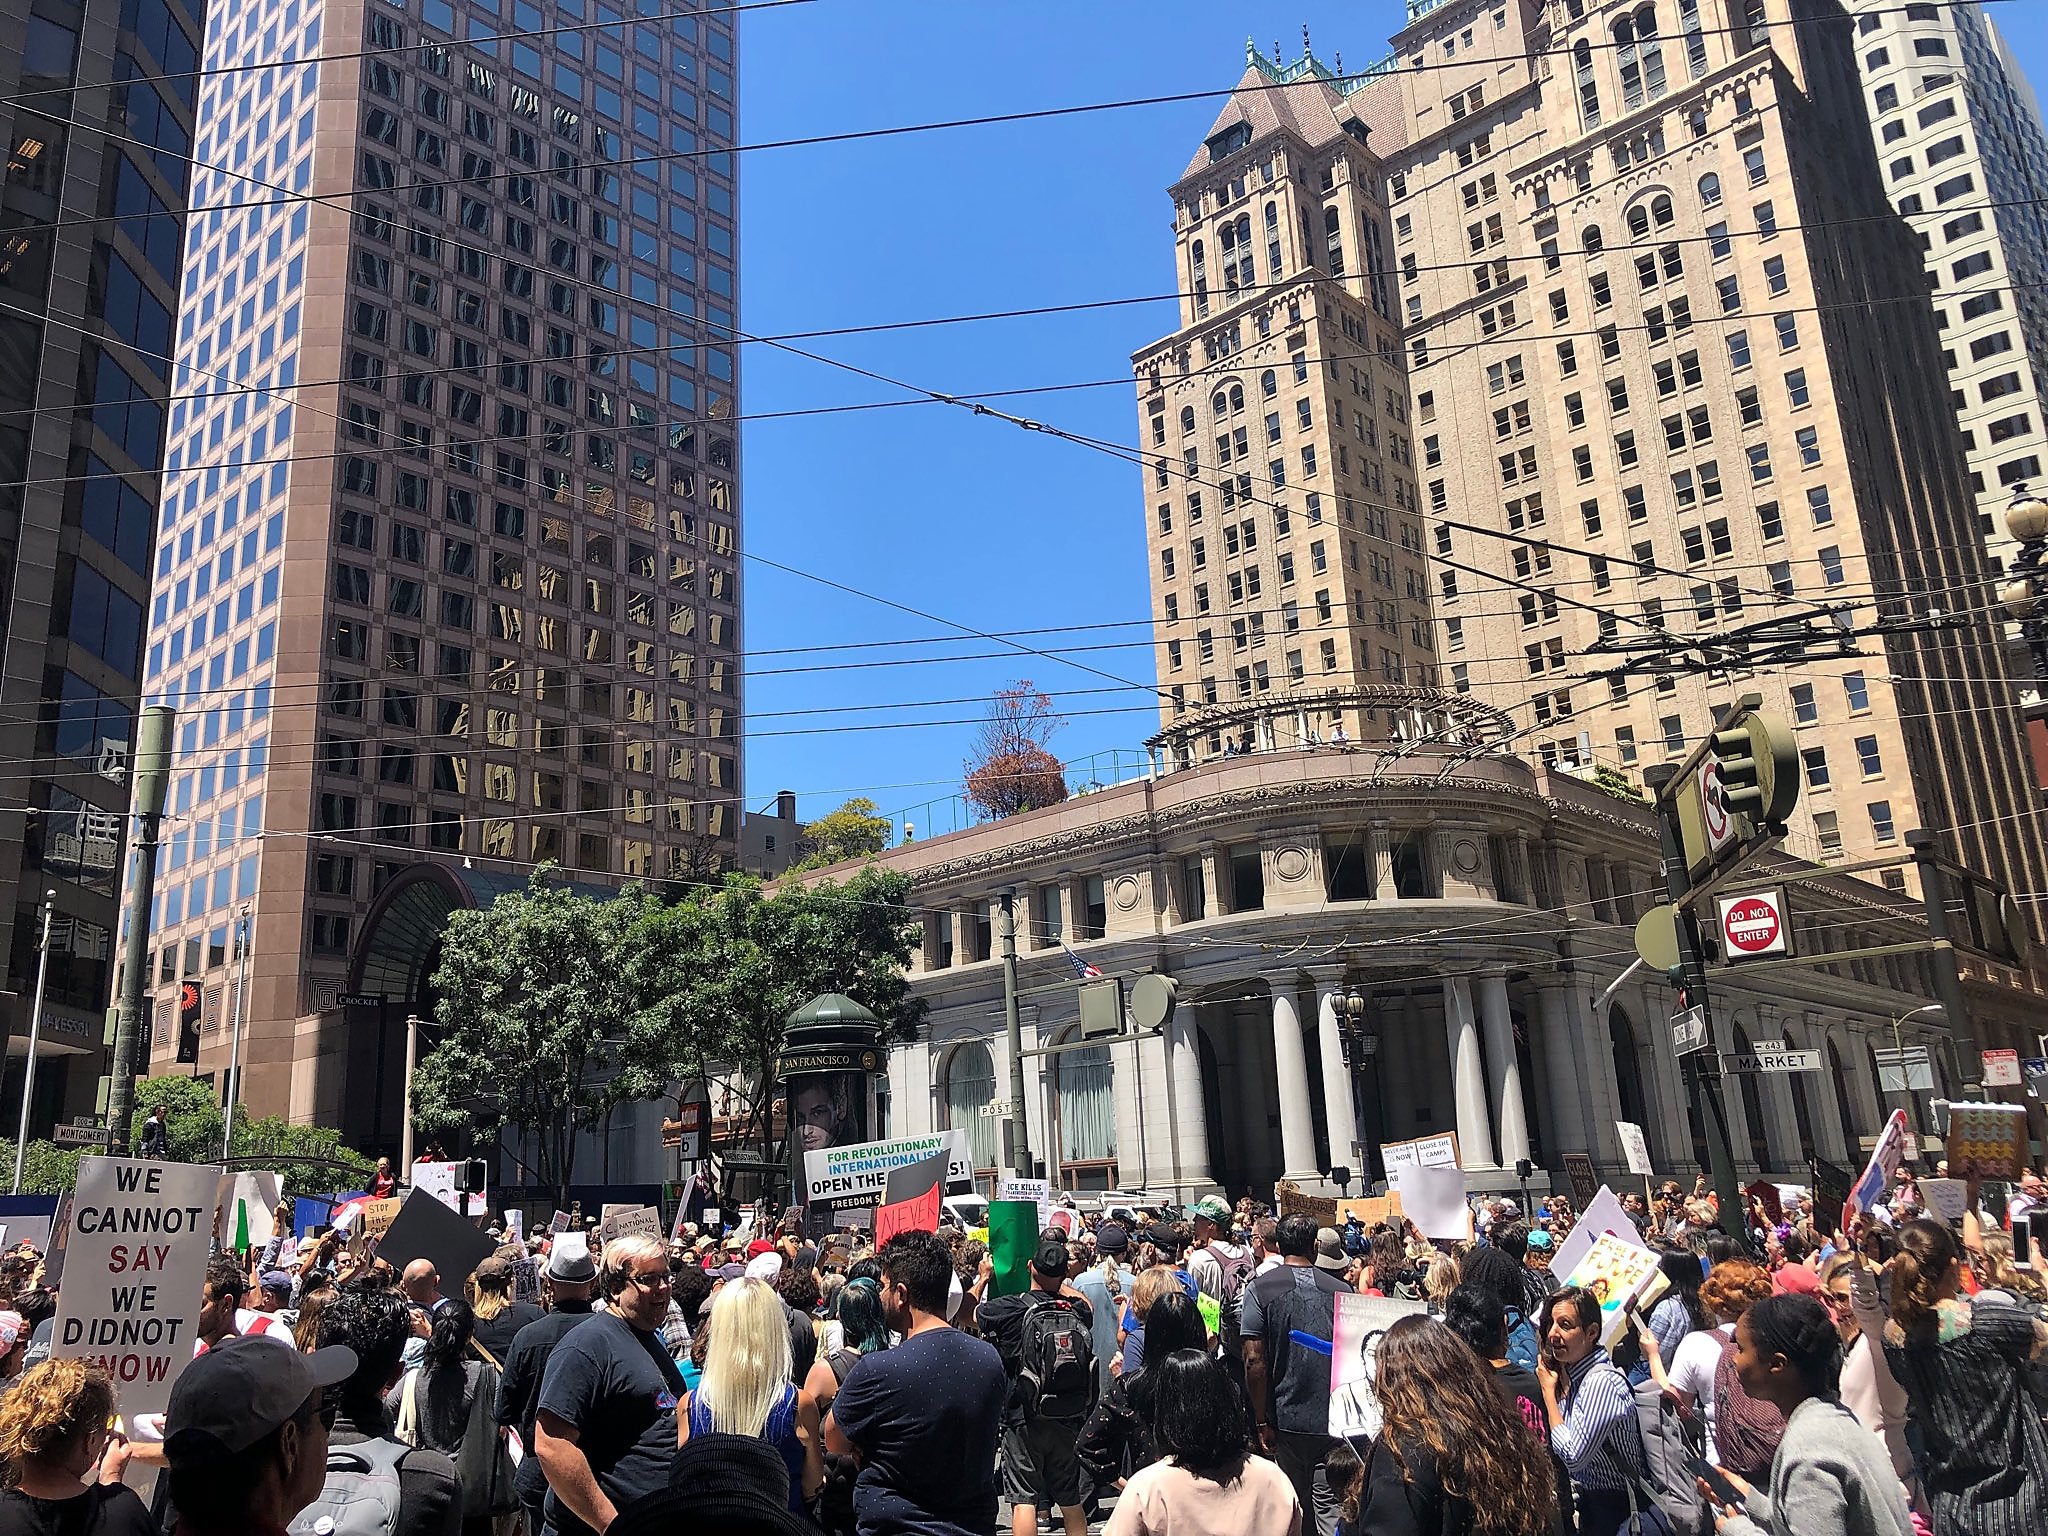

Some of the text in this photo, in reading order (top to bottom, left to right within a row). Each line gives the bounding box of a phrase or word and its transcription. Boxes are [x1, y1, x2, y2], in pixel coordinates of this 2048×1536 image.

[1730, 907, 1769, 921] DO NOT
[1737, 929, 1769, 943] ENTER
[339, 996, 379, 1006] CROCKER
[1765, 1041, 1781, 1050] 643
[785, 1055, 850, 1068] SAN FRANCISCO
[1739, 1055, 1806, 1069] MARKET
[982, 1104, 1010, 1115] POST
[60, 1129, 106, 1141] MONTGOMERY
[827, 1137, 944, 1163] FOR REVOLUTIONARY
[1420, 1141, 1437, 1150] CLOSE
[1395, 1153, 1412, 1161] NOW
[1425, 1149, 1447, 1158] CAMPS
[116, 1165, 163, 1194] WE
[811, 1172, 886, 1195] OPEN THE
[1021, 1183, 1042, 1191] KILLS
[368, 1203, 389, 1214] STOP
[831, 1196, 870, 1209] FREEDOM
[77, 1206, 203, 1234] CANNOT
[370, 1215, 387, 1225] THE
[618, 1217, 654, 1230] NATIONAL
[971, 1230, 989, 1241] ASYL
[109, 1244, 171, 1274] SAY
[111, 1285, 157, 1313] WE
[79, 1353, 171, 1383] NOW
